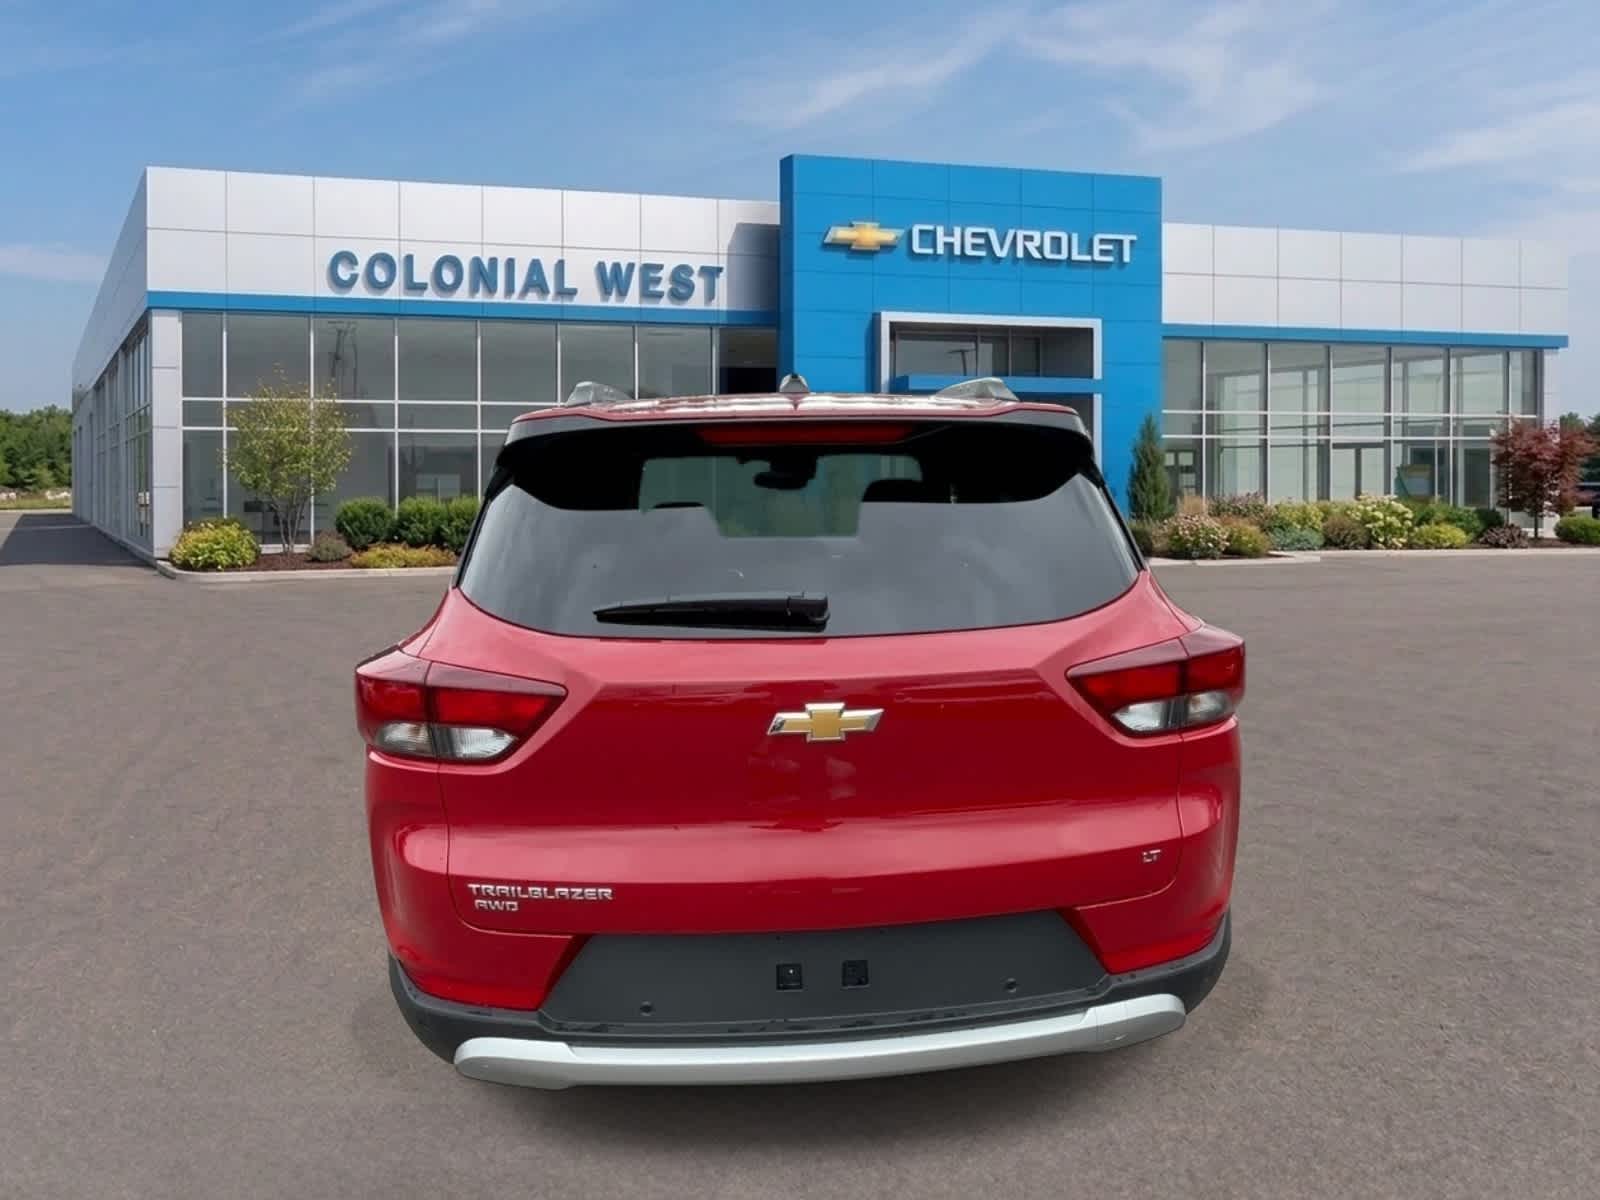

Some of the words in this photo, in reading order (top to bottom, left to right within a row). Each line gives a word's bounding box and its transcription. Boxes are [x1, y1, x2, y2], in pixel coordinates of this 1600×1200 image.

[911, 223, 1138, 264] CHEVROLET
[327, 250, 578, 298] COLONIAL
[596, 261, 723, 303] WEST
[1142, 849, 1161, 863] LT
[467, 883, 613, 900] TRAILBLAZER
[474, 899, 519, 912] AWD
